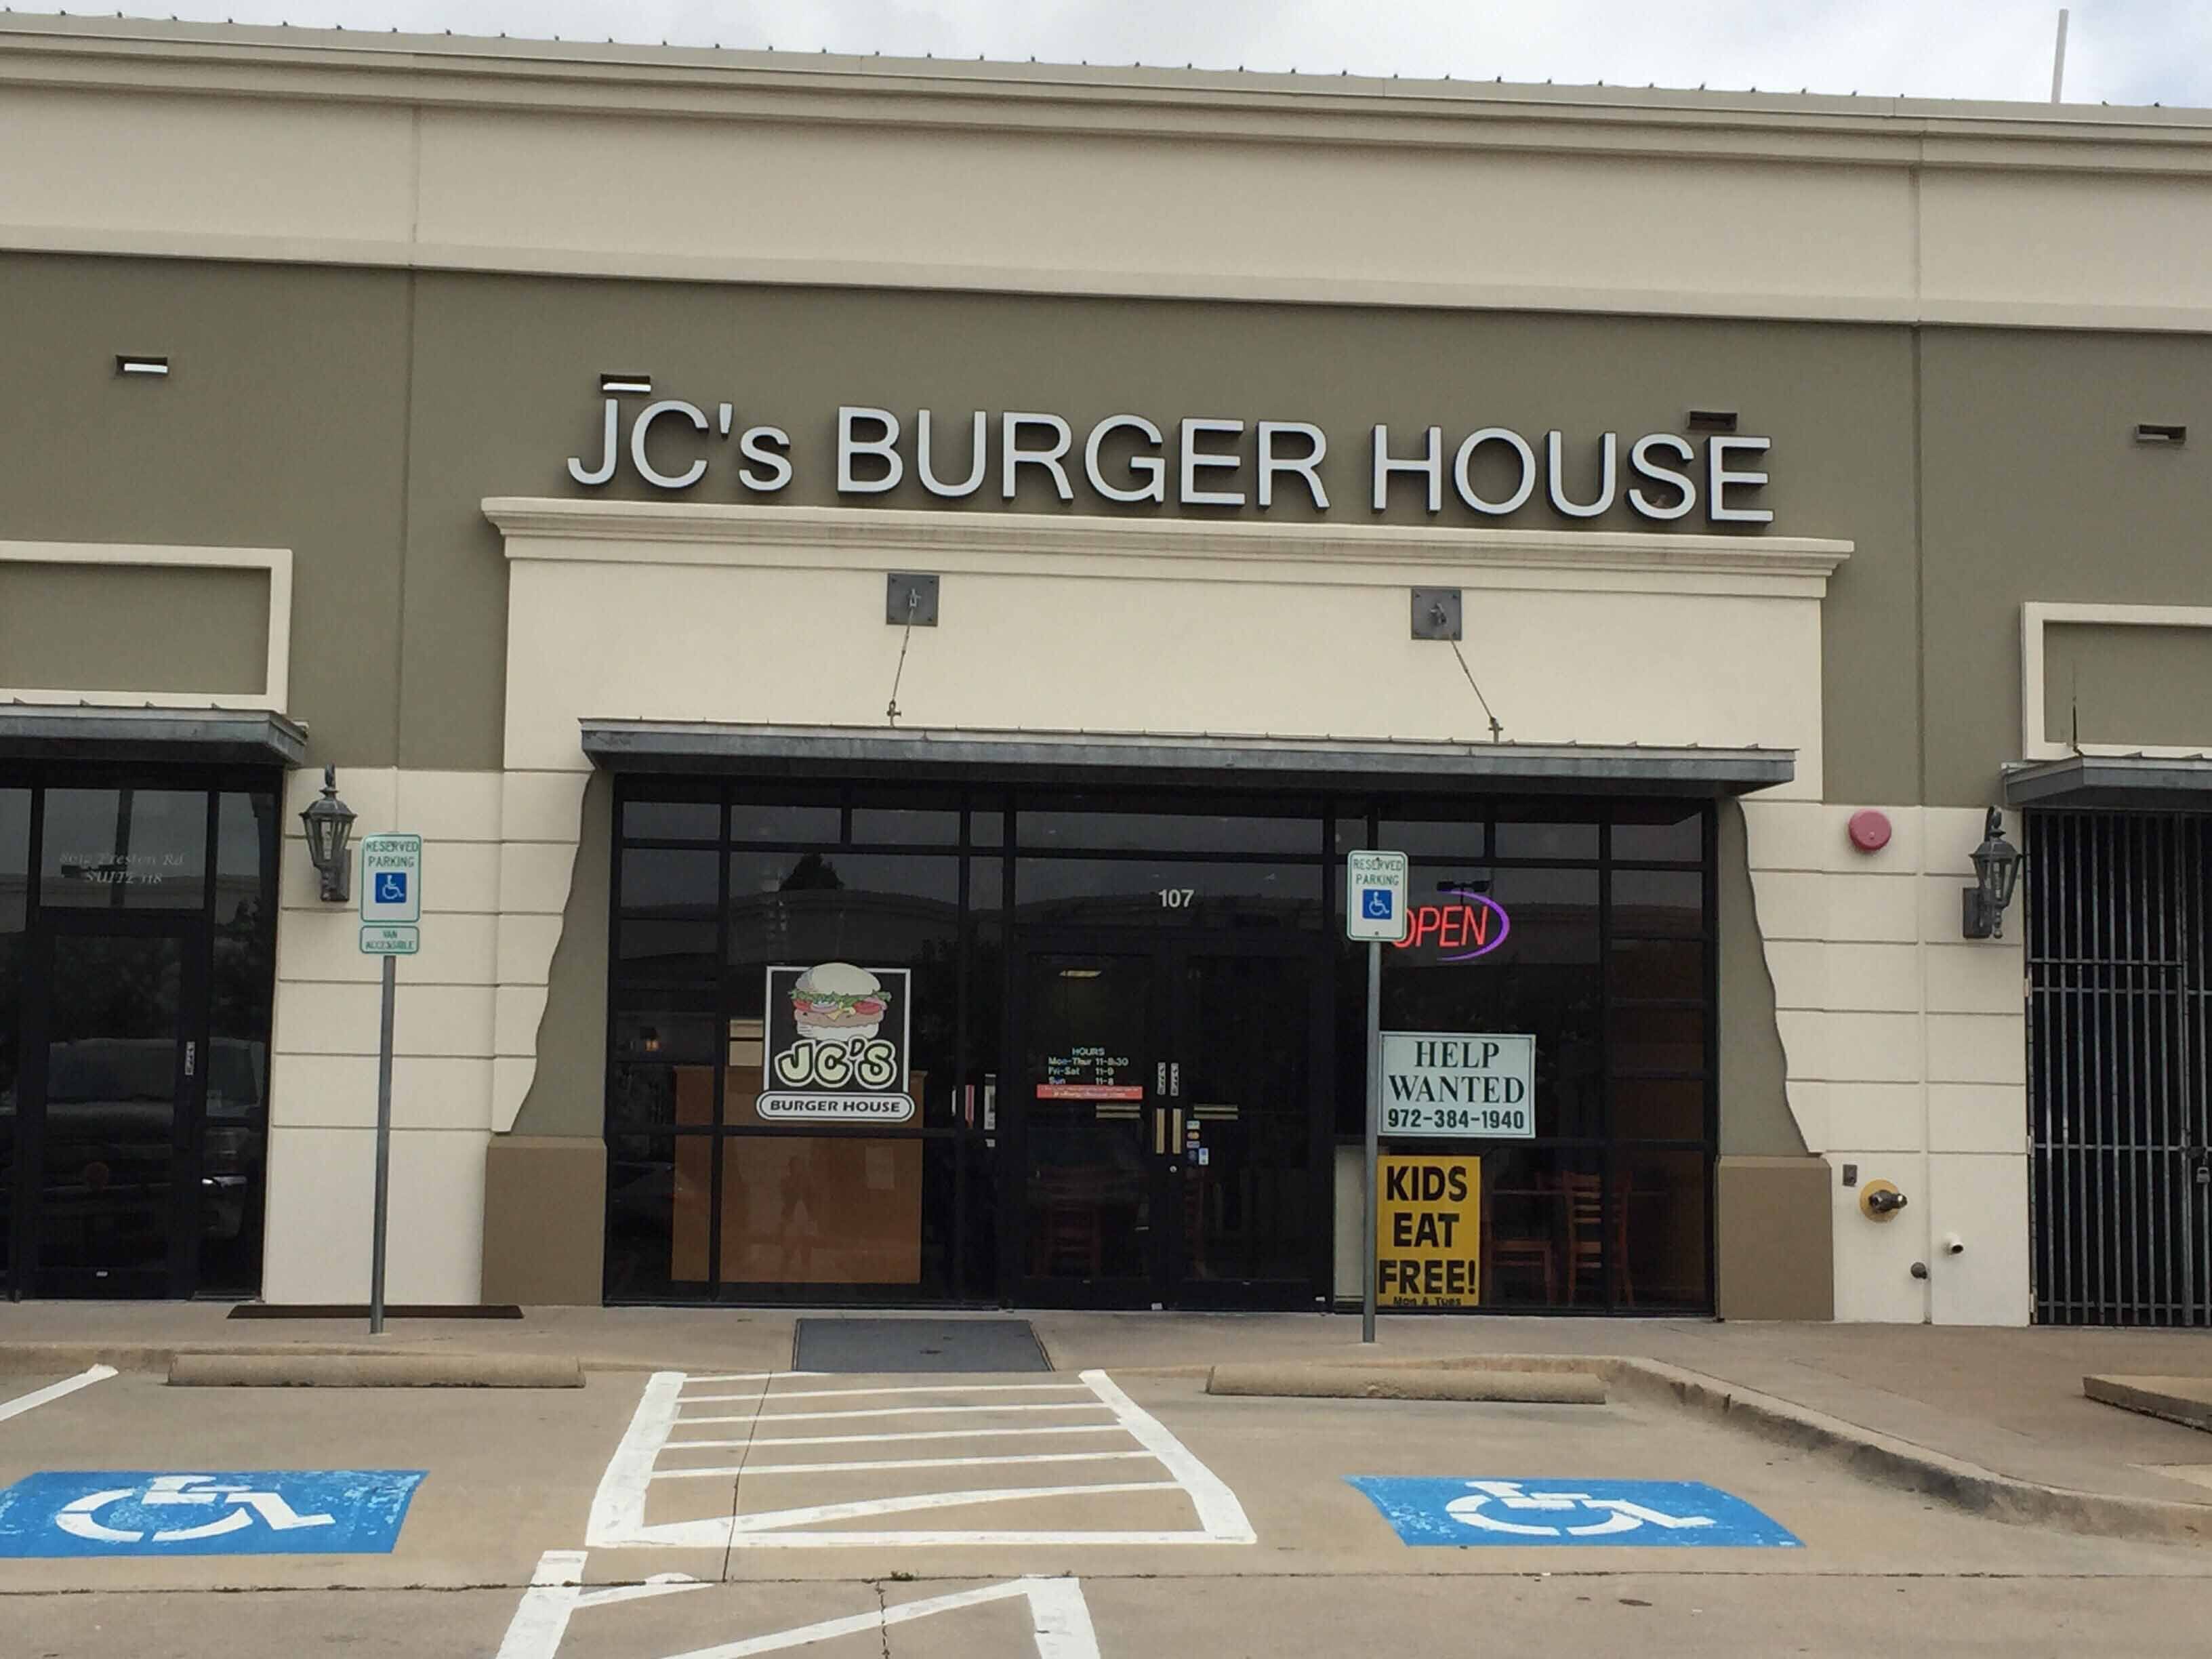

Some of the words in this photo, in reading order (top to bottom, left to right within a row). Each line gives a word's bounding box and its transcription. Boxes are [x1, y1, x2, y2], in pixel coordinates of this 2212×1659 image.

[567, 398, 792, 491] JC's
[837, 406, 1330, 509] BURGER
[1370, 422, 1773, 522] HOUSE
[366, 840, 419, 853] RESERVED
[368, 855, 415, 868] PARKING
[1353, 858, 1403, 872] RESERVED
[1356, 873, 1399, 886] PARKING
[1158, 888, 1195, 907] 107
[382, 930, 398, 939] VAN
[365, 941, 414, 950] ACCESSIBLE
[1071, 1046, 1105, 1057] HOURS
[1414, 1040, 1500, 1069] HELP
[1388, 1074, 1525, 1104] WANTED
[770, 1099, 839, 1112] BURGER
[842, 1101, 901, 1113] HOUSE
[1387, 1109, 1525, 1130] 972-384-1940
[1386, 1165, 1468, 1202] KIDS
[1393, 1212, 1460, 1248] EAT
[1378, 1259, 1476, 1295] FREE!
